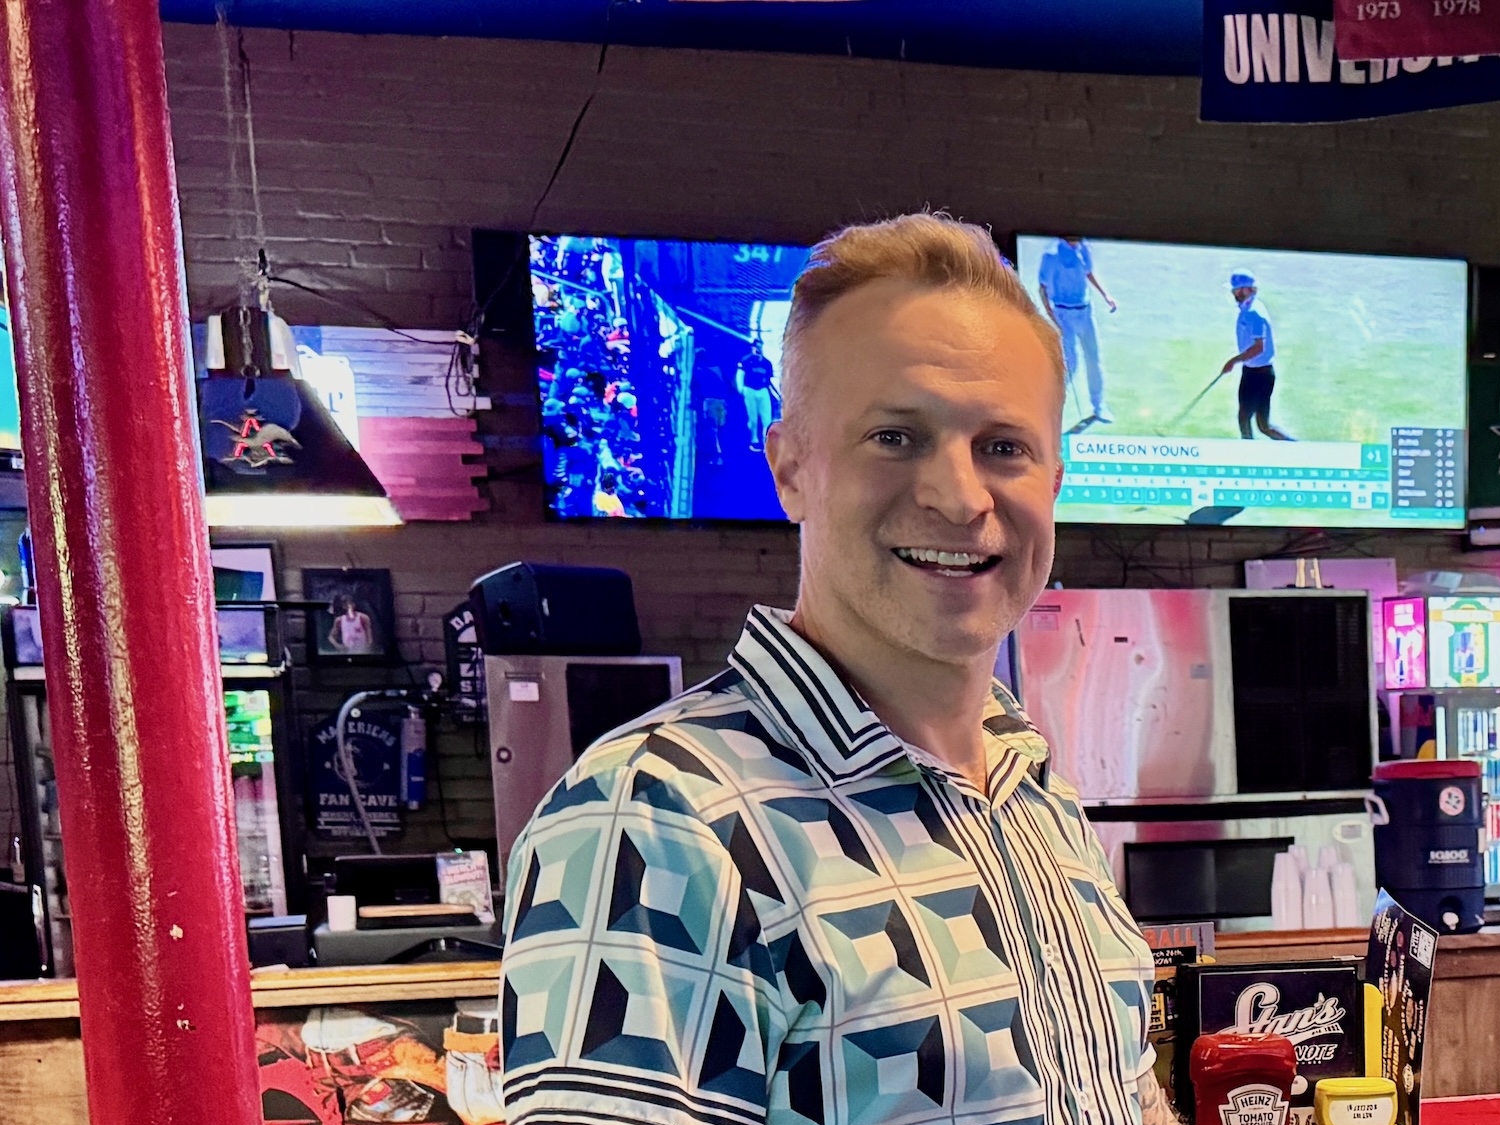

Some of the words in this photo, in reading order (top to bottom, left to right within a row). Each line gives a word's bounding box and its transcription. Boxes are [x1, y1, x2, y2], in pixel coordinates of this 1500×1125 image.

[1355, 1, 1401, 20] 1973
[1076, 443, 1147, 456] CAMERON
[1151, 445, 1200, 457] YOUNG
[316, 721, 397, 747] MAERICKS
[319, 793, 350, 806] FAN
[359, 794, 398, 807] CAVE
[1430, 850, 1468, 860] IGLOO
[1217, 982, 1346, 1035] Stan's
[1295, 1044, 1338, 1061] NOTE
[1240, 1096, 1271, 1108] HEINZ
[1238, 1112, 1274, 1123] TOMATO
